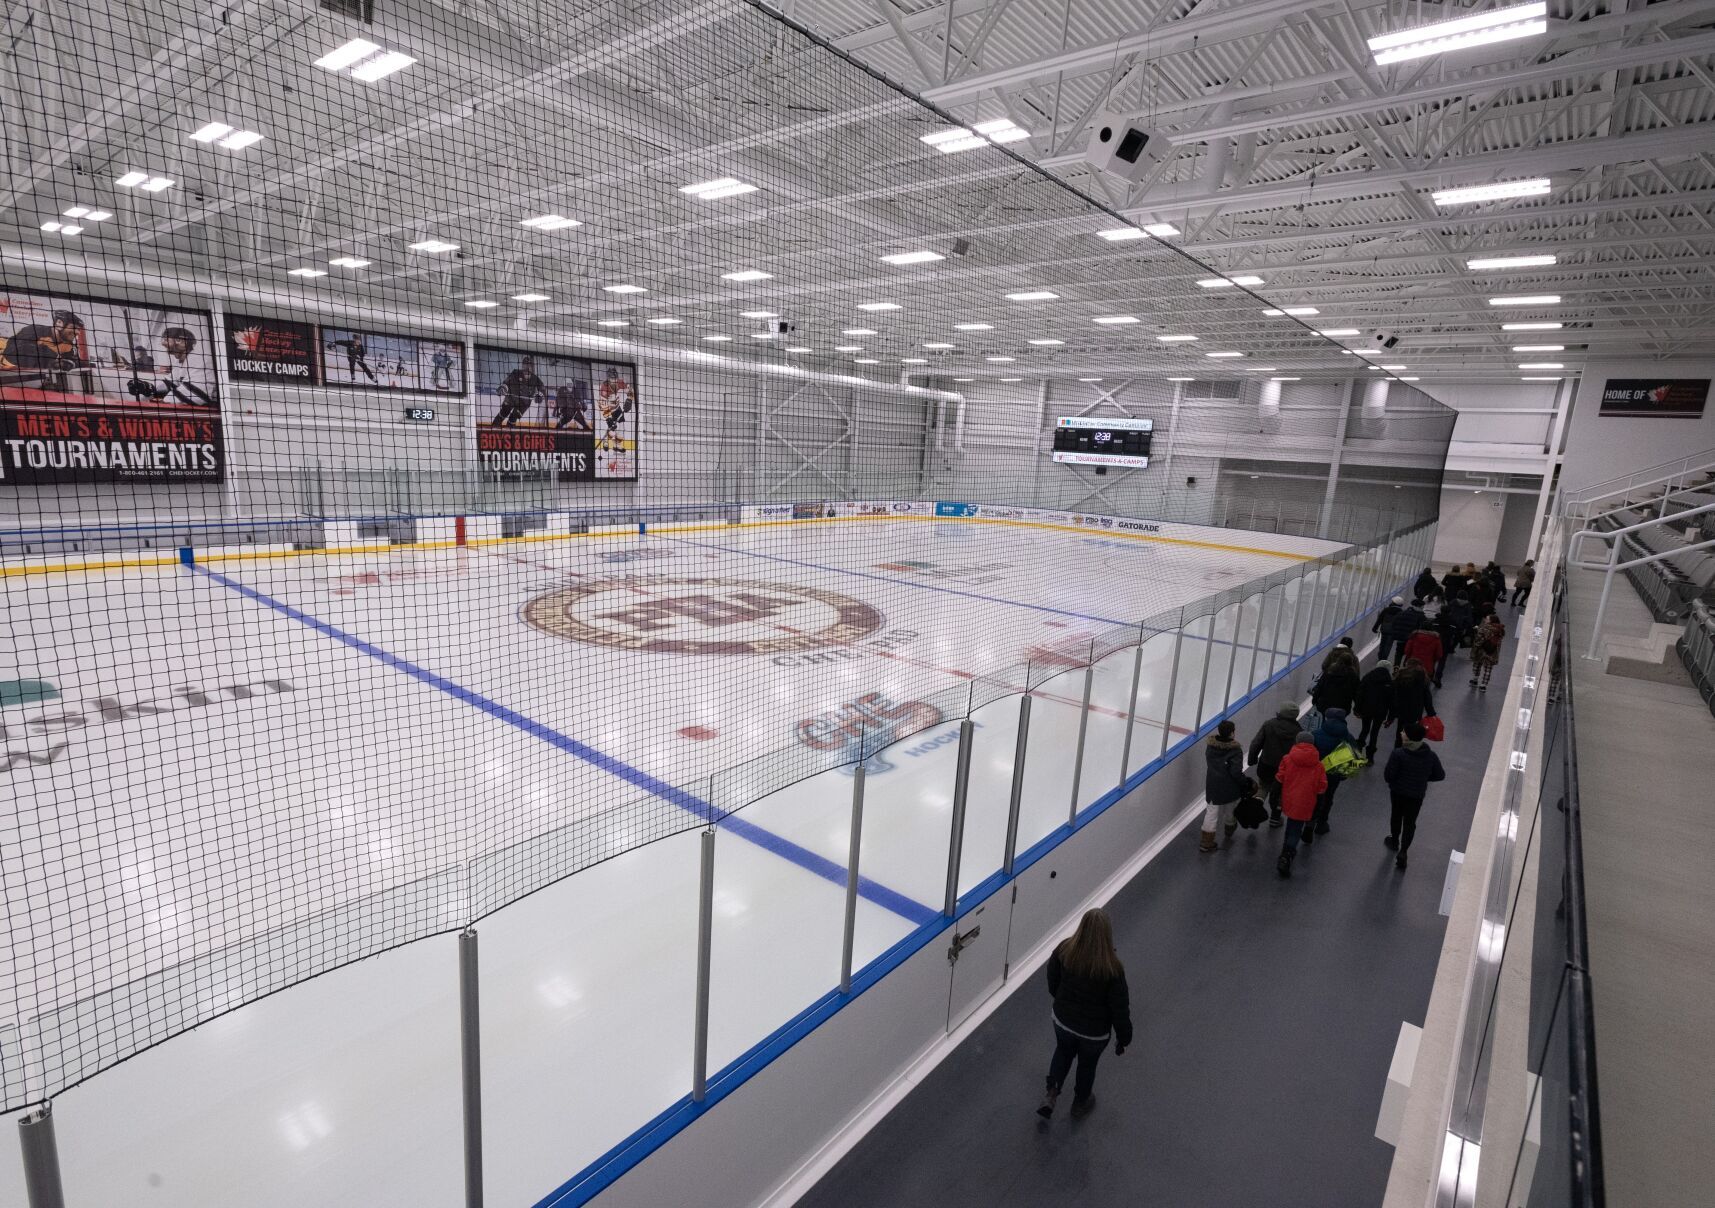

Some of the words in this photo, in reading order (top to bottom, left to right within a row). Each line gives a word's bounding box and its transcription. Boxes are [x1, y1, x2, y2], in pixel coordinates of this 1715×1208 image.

[233, 359, 273, 374] HOCKEY
[275, 362, 309, 376] CAMPS
[1604, 389, 1632, 400] HOME
[1633, 390, 1647, 400] OF
[412, 409, 432, 420] 12:38
[16, 414, 90, 437] MEN'S
[97, 416, 112, 438] &
[118, 418, 215, 442] WOMEN'S
[480, 433, 512, 450] BOYS
[514, 434, 521, 449] &
[523, 435, 555, 450] GIRLS
[5, 439, 217, 470] TOURNAMENTS
[482, 450, 587, 472] TOURNAMENTS
[1118, 521, 1160, 533] GATORADE
